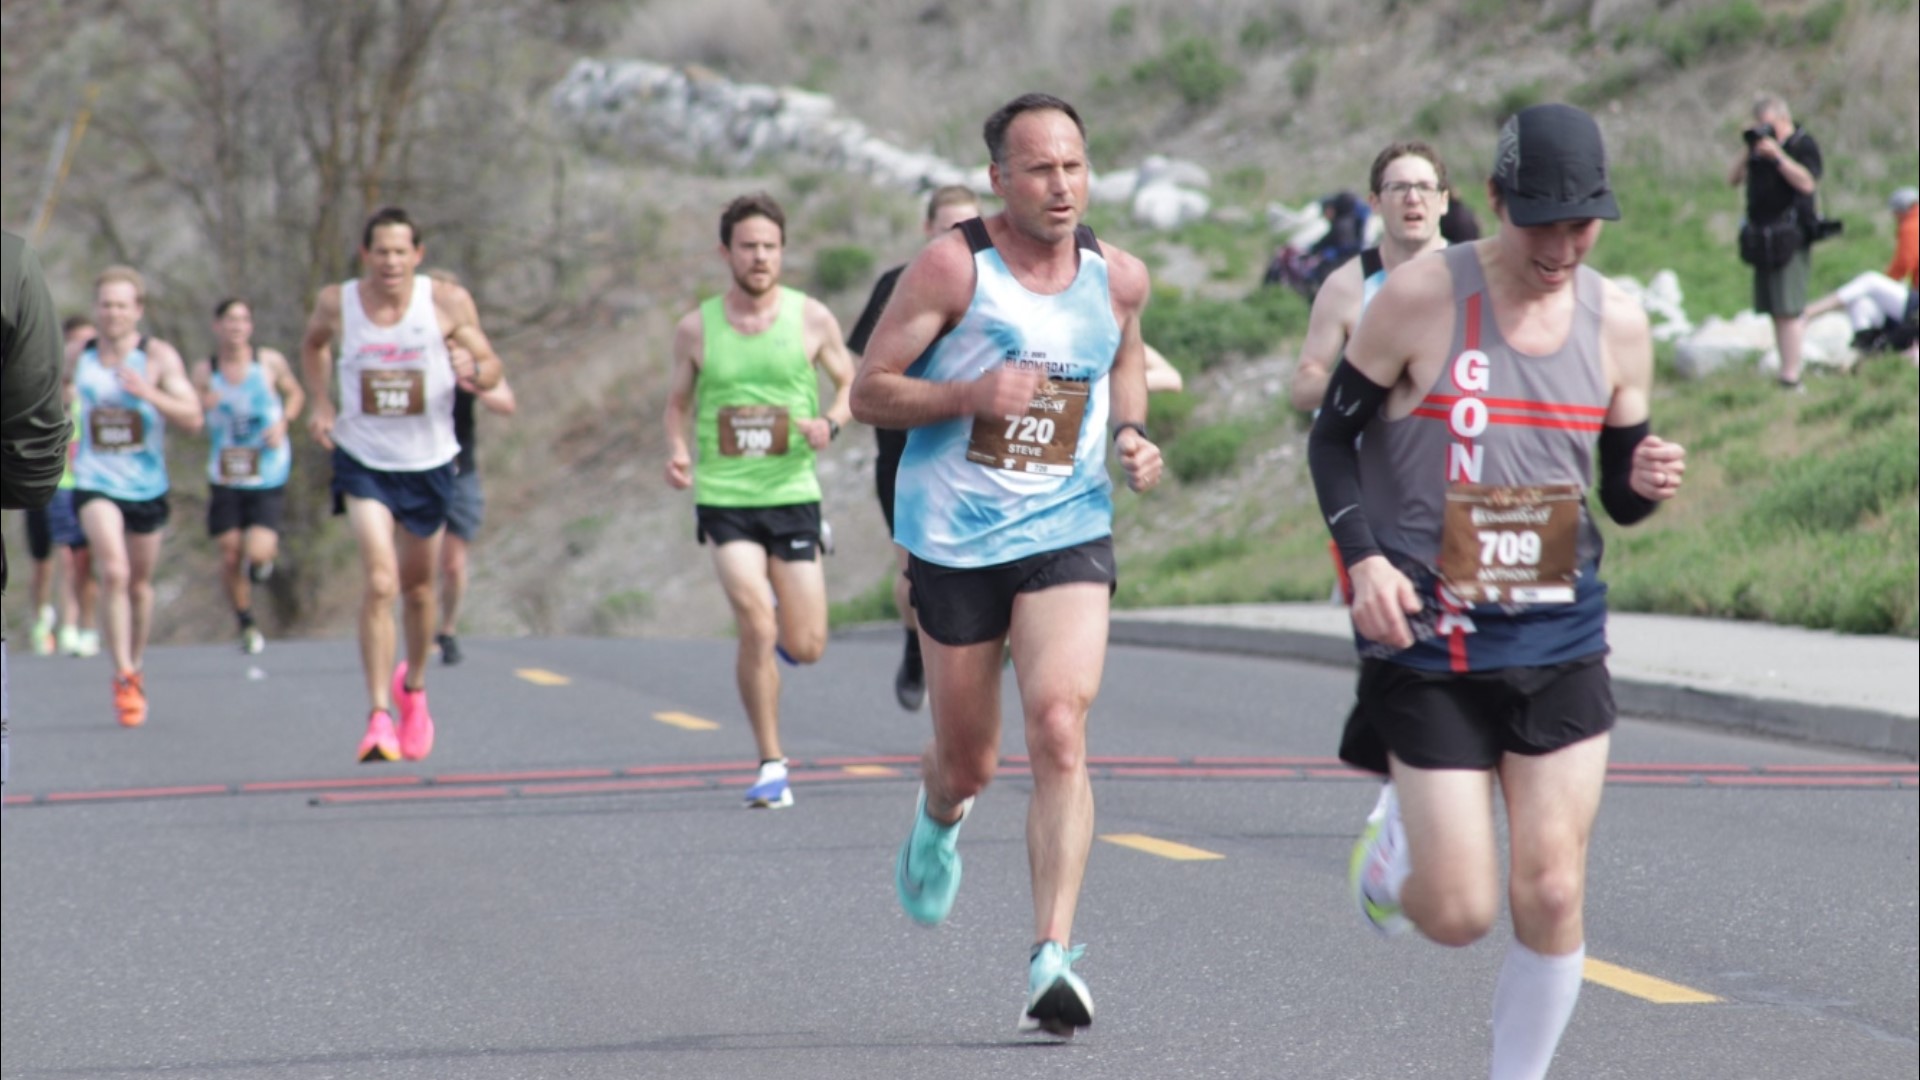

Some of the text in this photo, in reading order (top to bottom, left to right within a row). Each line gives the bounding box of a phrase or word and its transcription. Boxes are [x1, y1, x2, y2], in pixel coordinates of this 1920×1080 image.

[1004, 415, 1055, 444] 720
[1008, 444, 1043, 456] STEVE
[1477, 530, 1542, 566] 709
